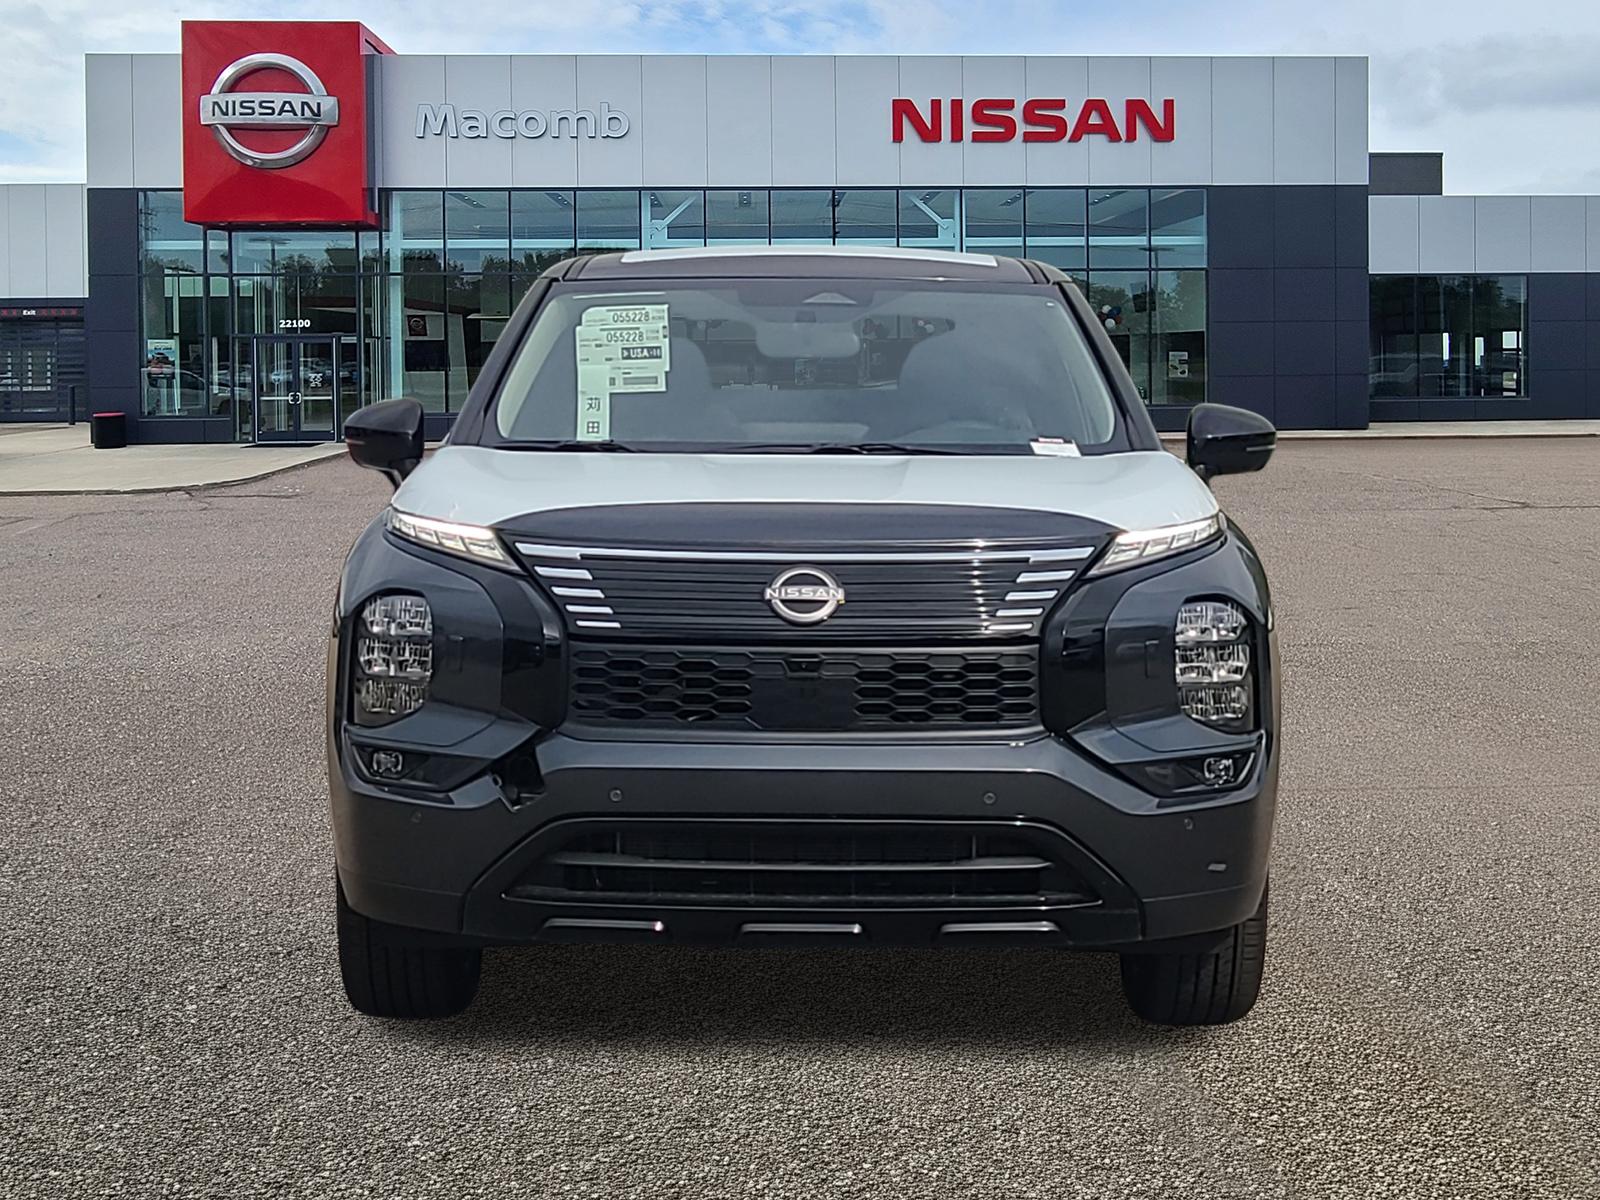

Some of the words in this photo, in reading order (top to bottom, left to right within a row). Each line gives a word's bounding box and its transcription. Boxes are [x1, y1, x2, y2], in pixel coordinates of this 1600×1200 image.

[211, 99, 322, 118] NISSAN
[415, 102, 630, 139] Macomb
[892, 98, 1175, 143] NISSAN
[612, 311, 650, 323] 055228
[279, 319, 311, 328] 22100
[606, 331, 644, 343] 055228
[767, 588, 842, 599] NISSAN
